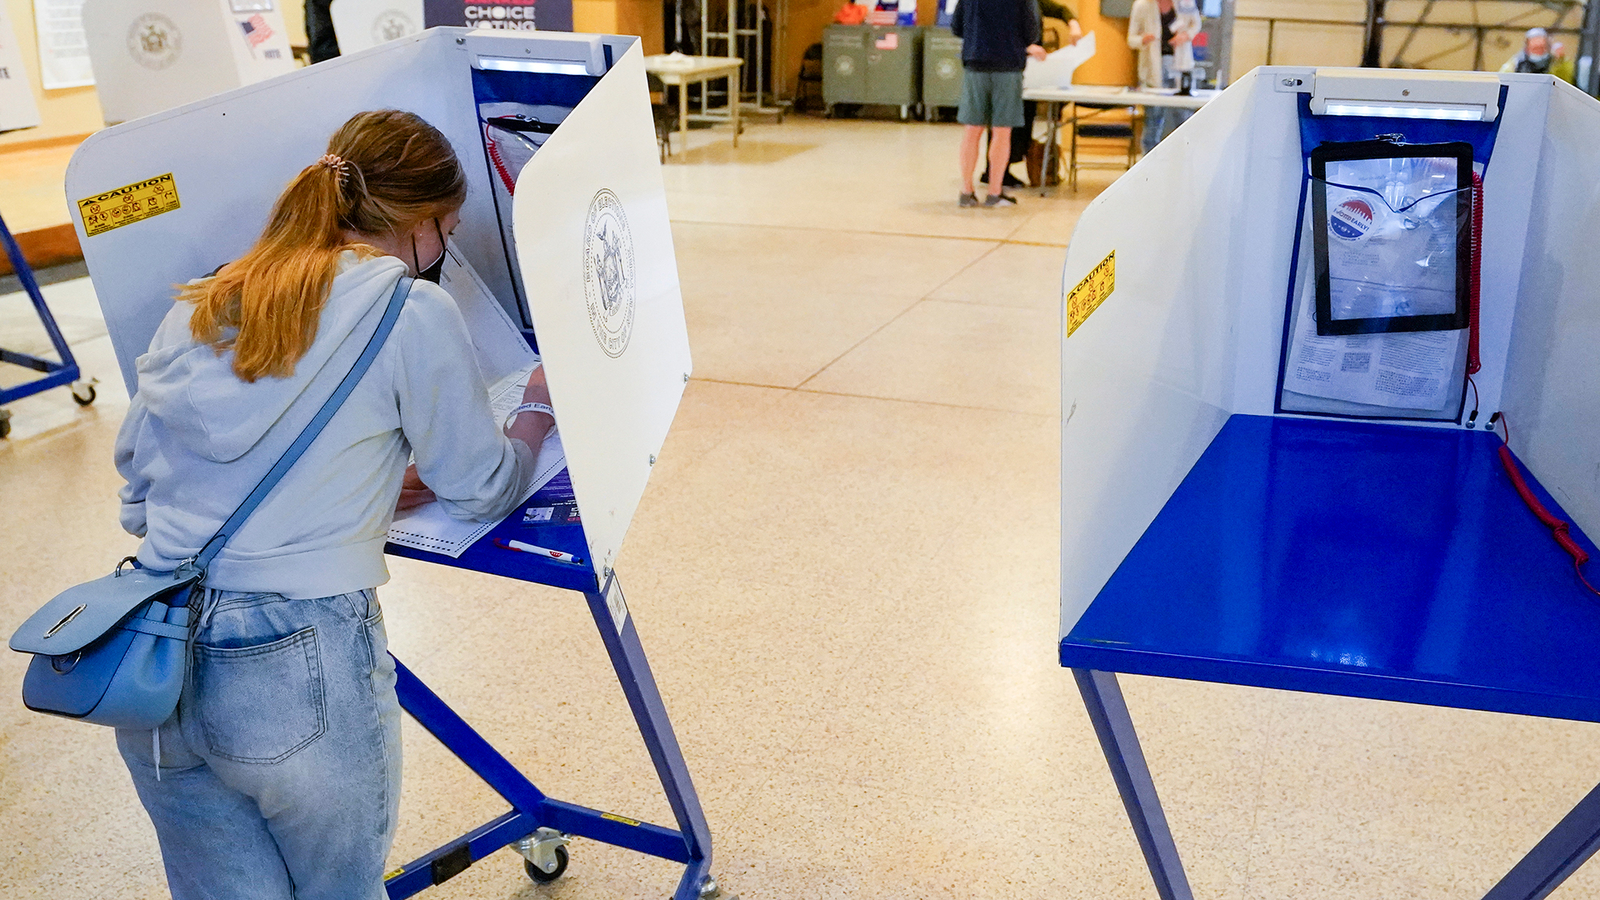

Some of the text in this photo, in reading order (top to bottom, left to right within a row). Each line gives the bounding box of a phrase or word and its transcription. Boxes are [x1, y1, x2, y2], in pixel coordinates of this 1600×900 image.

[464, 6, 536, 19] CHOICE
[97, 175, 171, 201] CAUTION
[1077, 252, 1115, 292] CAUTION
